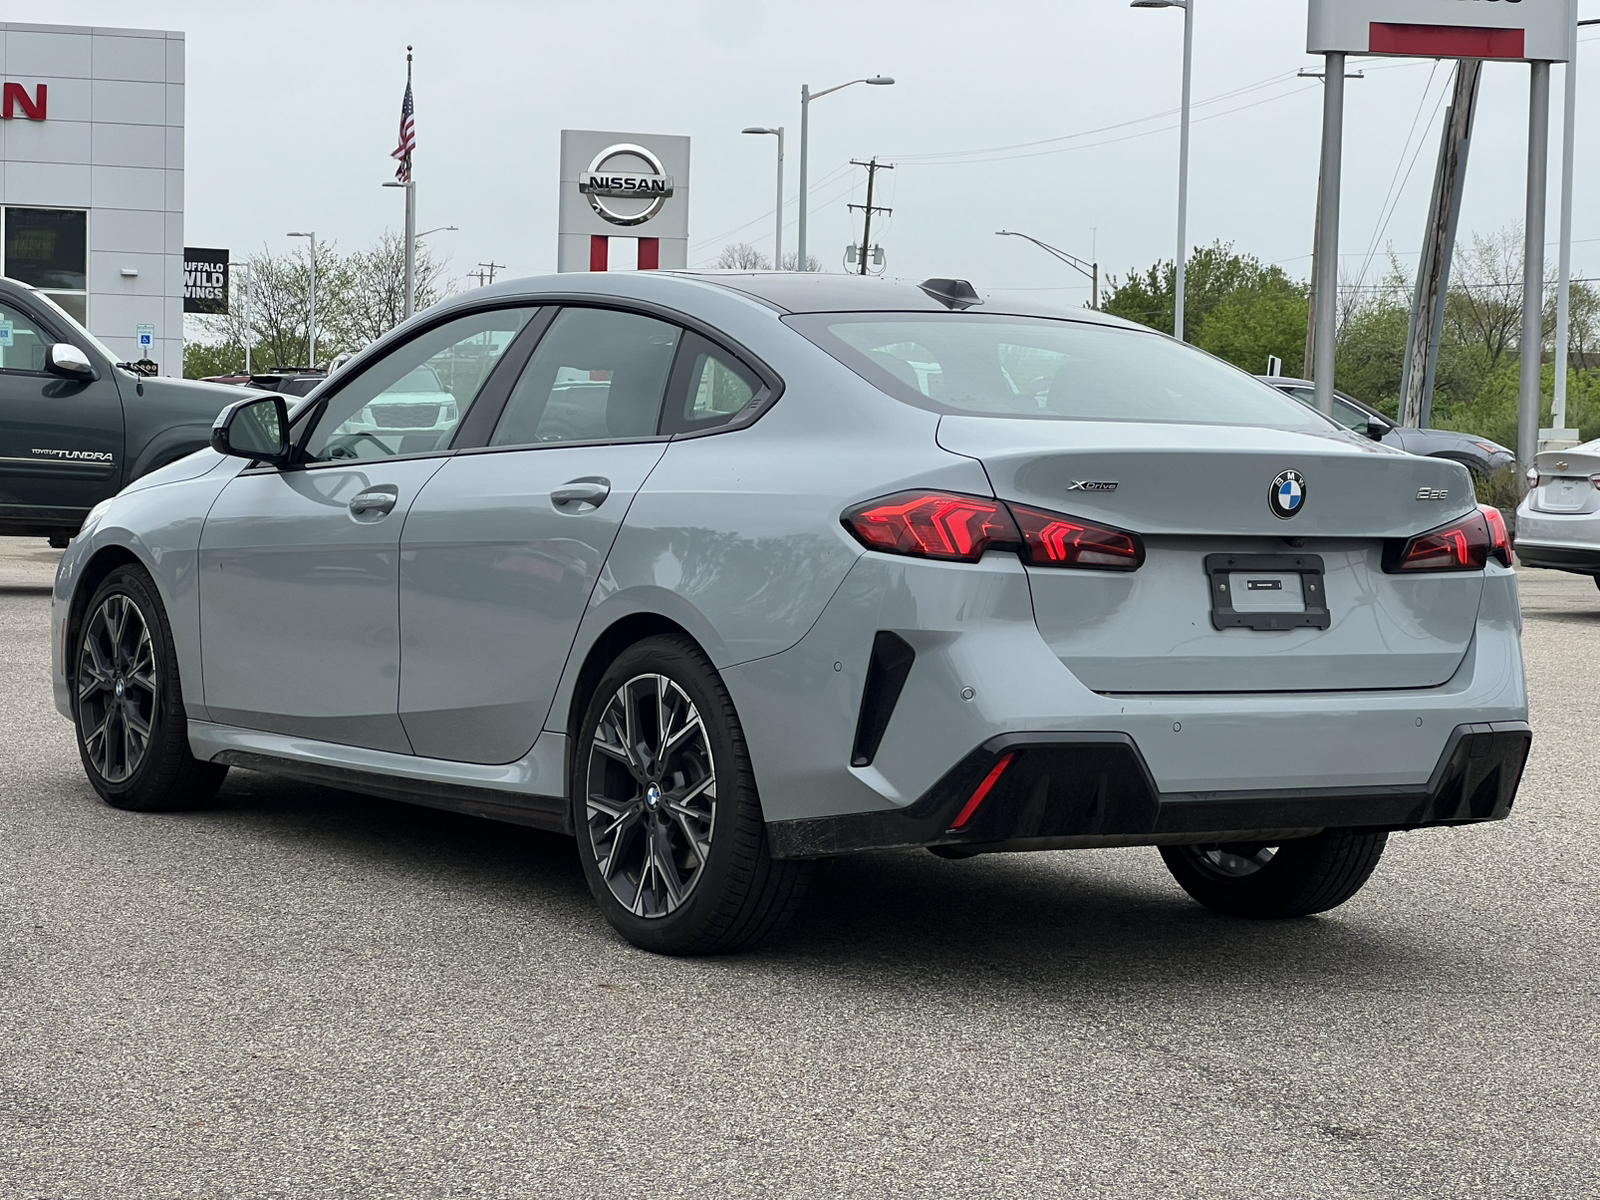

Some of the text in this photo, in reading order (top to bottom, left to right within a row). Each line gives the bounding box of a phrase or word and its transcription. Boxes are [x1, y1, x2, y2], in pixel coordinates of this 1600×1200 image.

[1, 82, 47, 121] N
[589, 176, 665, 191] NISSAN
[184, 261, 224, 272] UFFALO
[56, 450, 113, 460] TUNDRA
[1274, 472, 1305, 488] BMW
